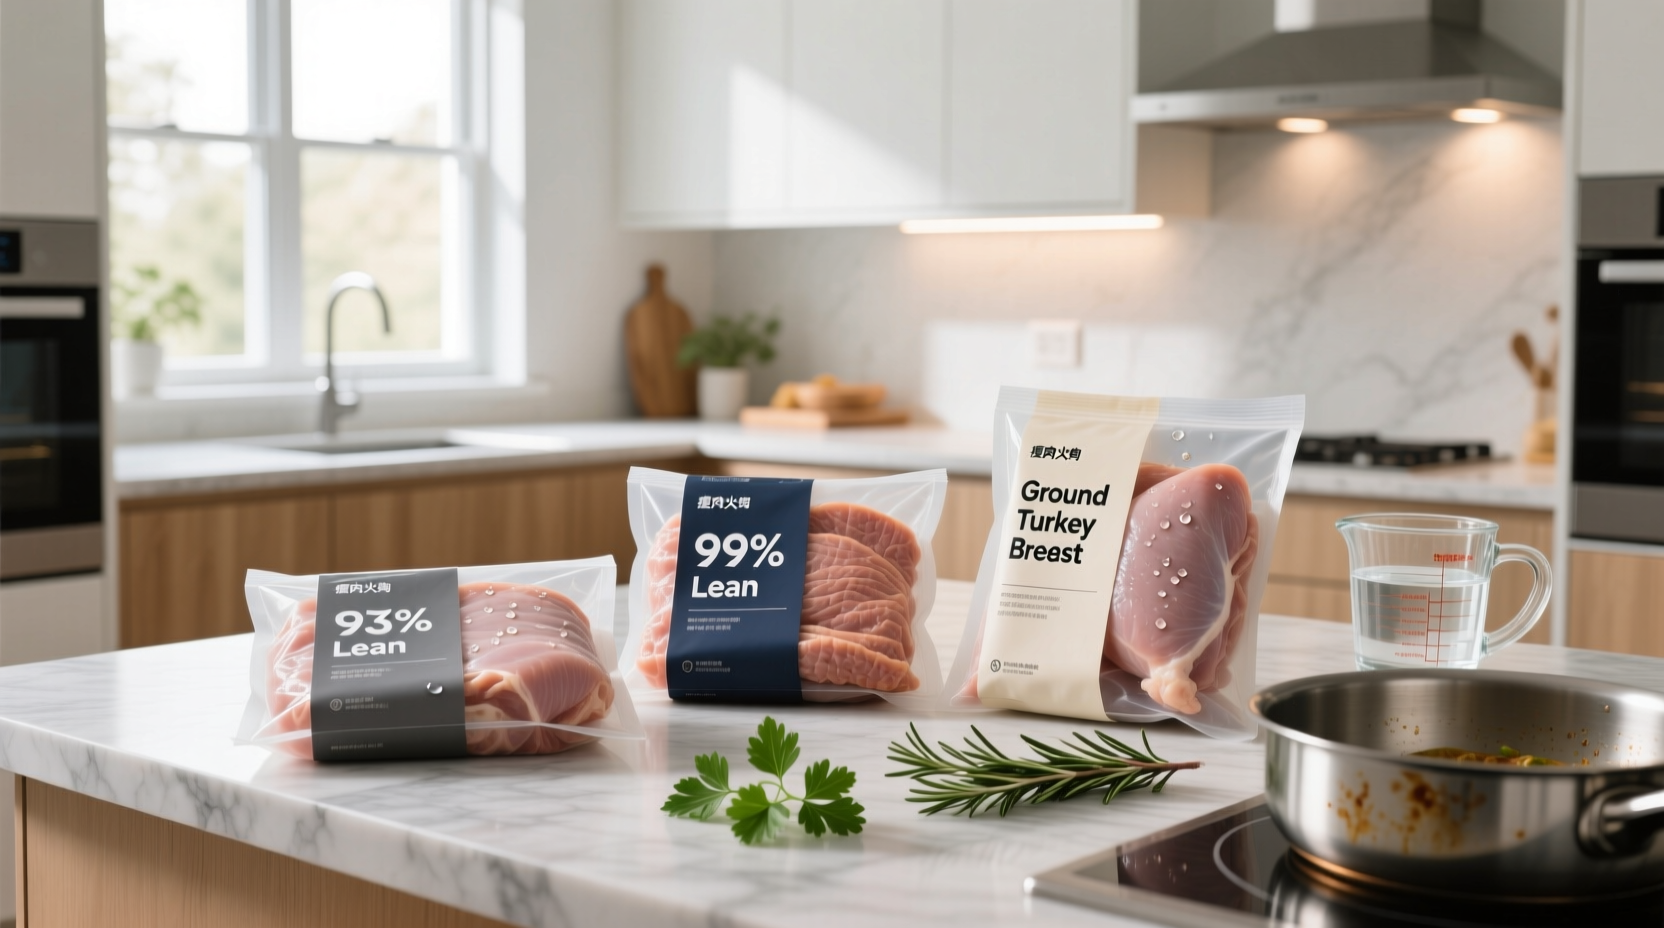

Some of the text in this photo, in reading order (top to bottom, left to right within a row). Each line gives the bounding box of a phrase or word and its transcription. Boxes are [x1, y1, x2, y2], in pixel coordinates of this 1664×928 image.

[1021, 480, 1110, 506] Ground
[1017, 508, 1097, 540] Turkey
[695, 532, 784, 568] 99%
[1009, 537, 1084, 565] Breast
[691, 575, 759, 598] Lean
[334, 607, 433, 637] 93%
[333, 640, 406, 658] Lean
